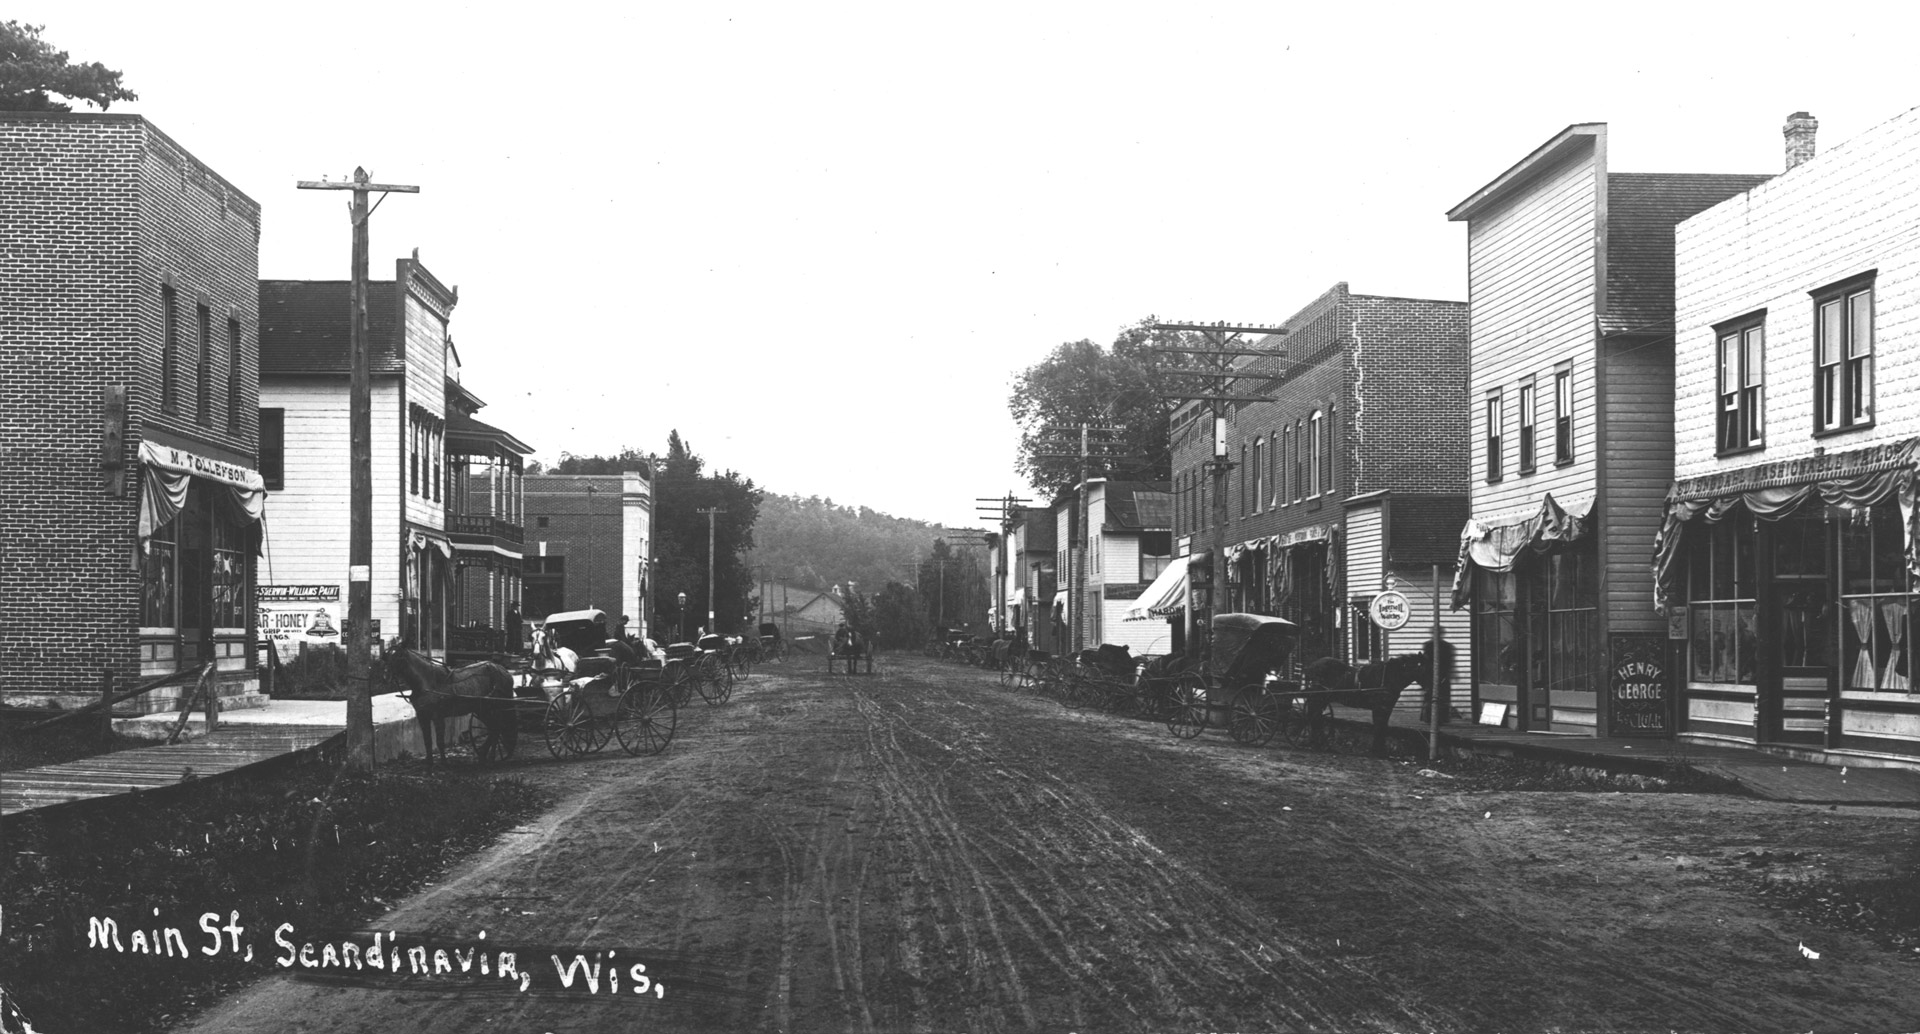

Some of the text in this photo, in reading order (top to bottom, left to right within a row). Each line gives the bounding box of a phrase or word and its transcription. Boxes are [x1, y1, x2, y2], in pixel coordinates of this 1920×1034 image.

[170, 450, 249, 483] M. TOLLEFSON.
[1754, 454, 1844, 482] FASHIONABLE
[318, 585, 340, 596] PAINT
[1618, 662, 1662, 680] HENRY
[1618, 683, 1662, 699] GEORGE
